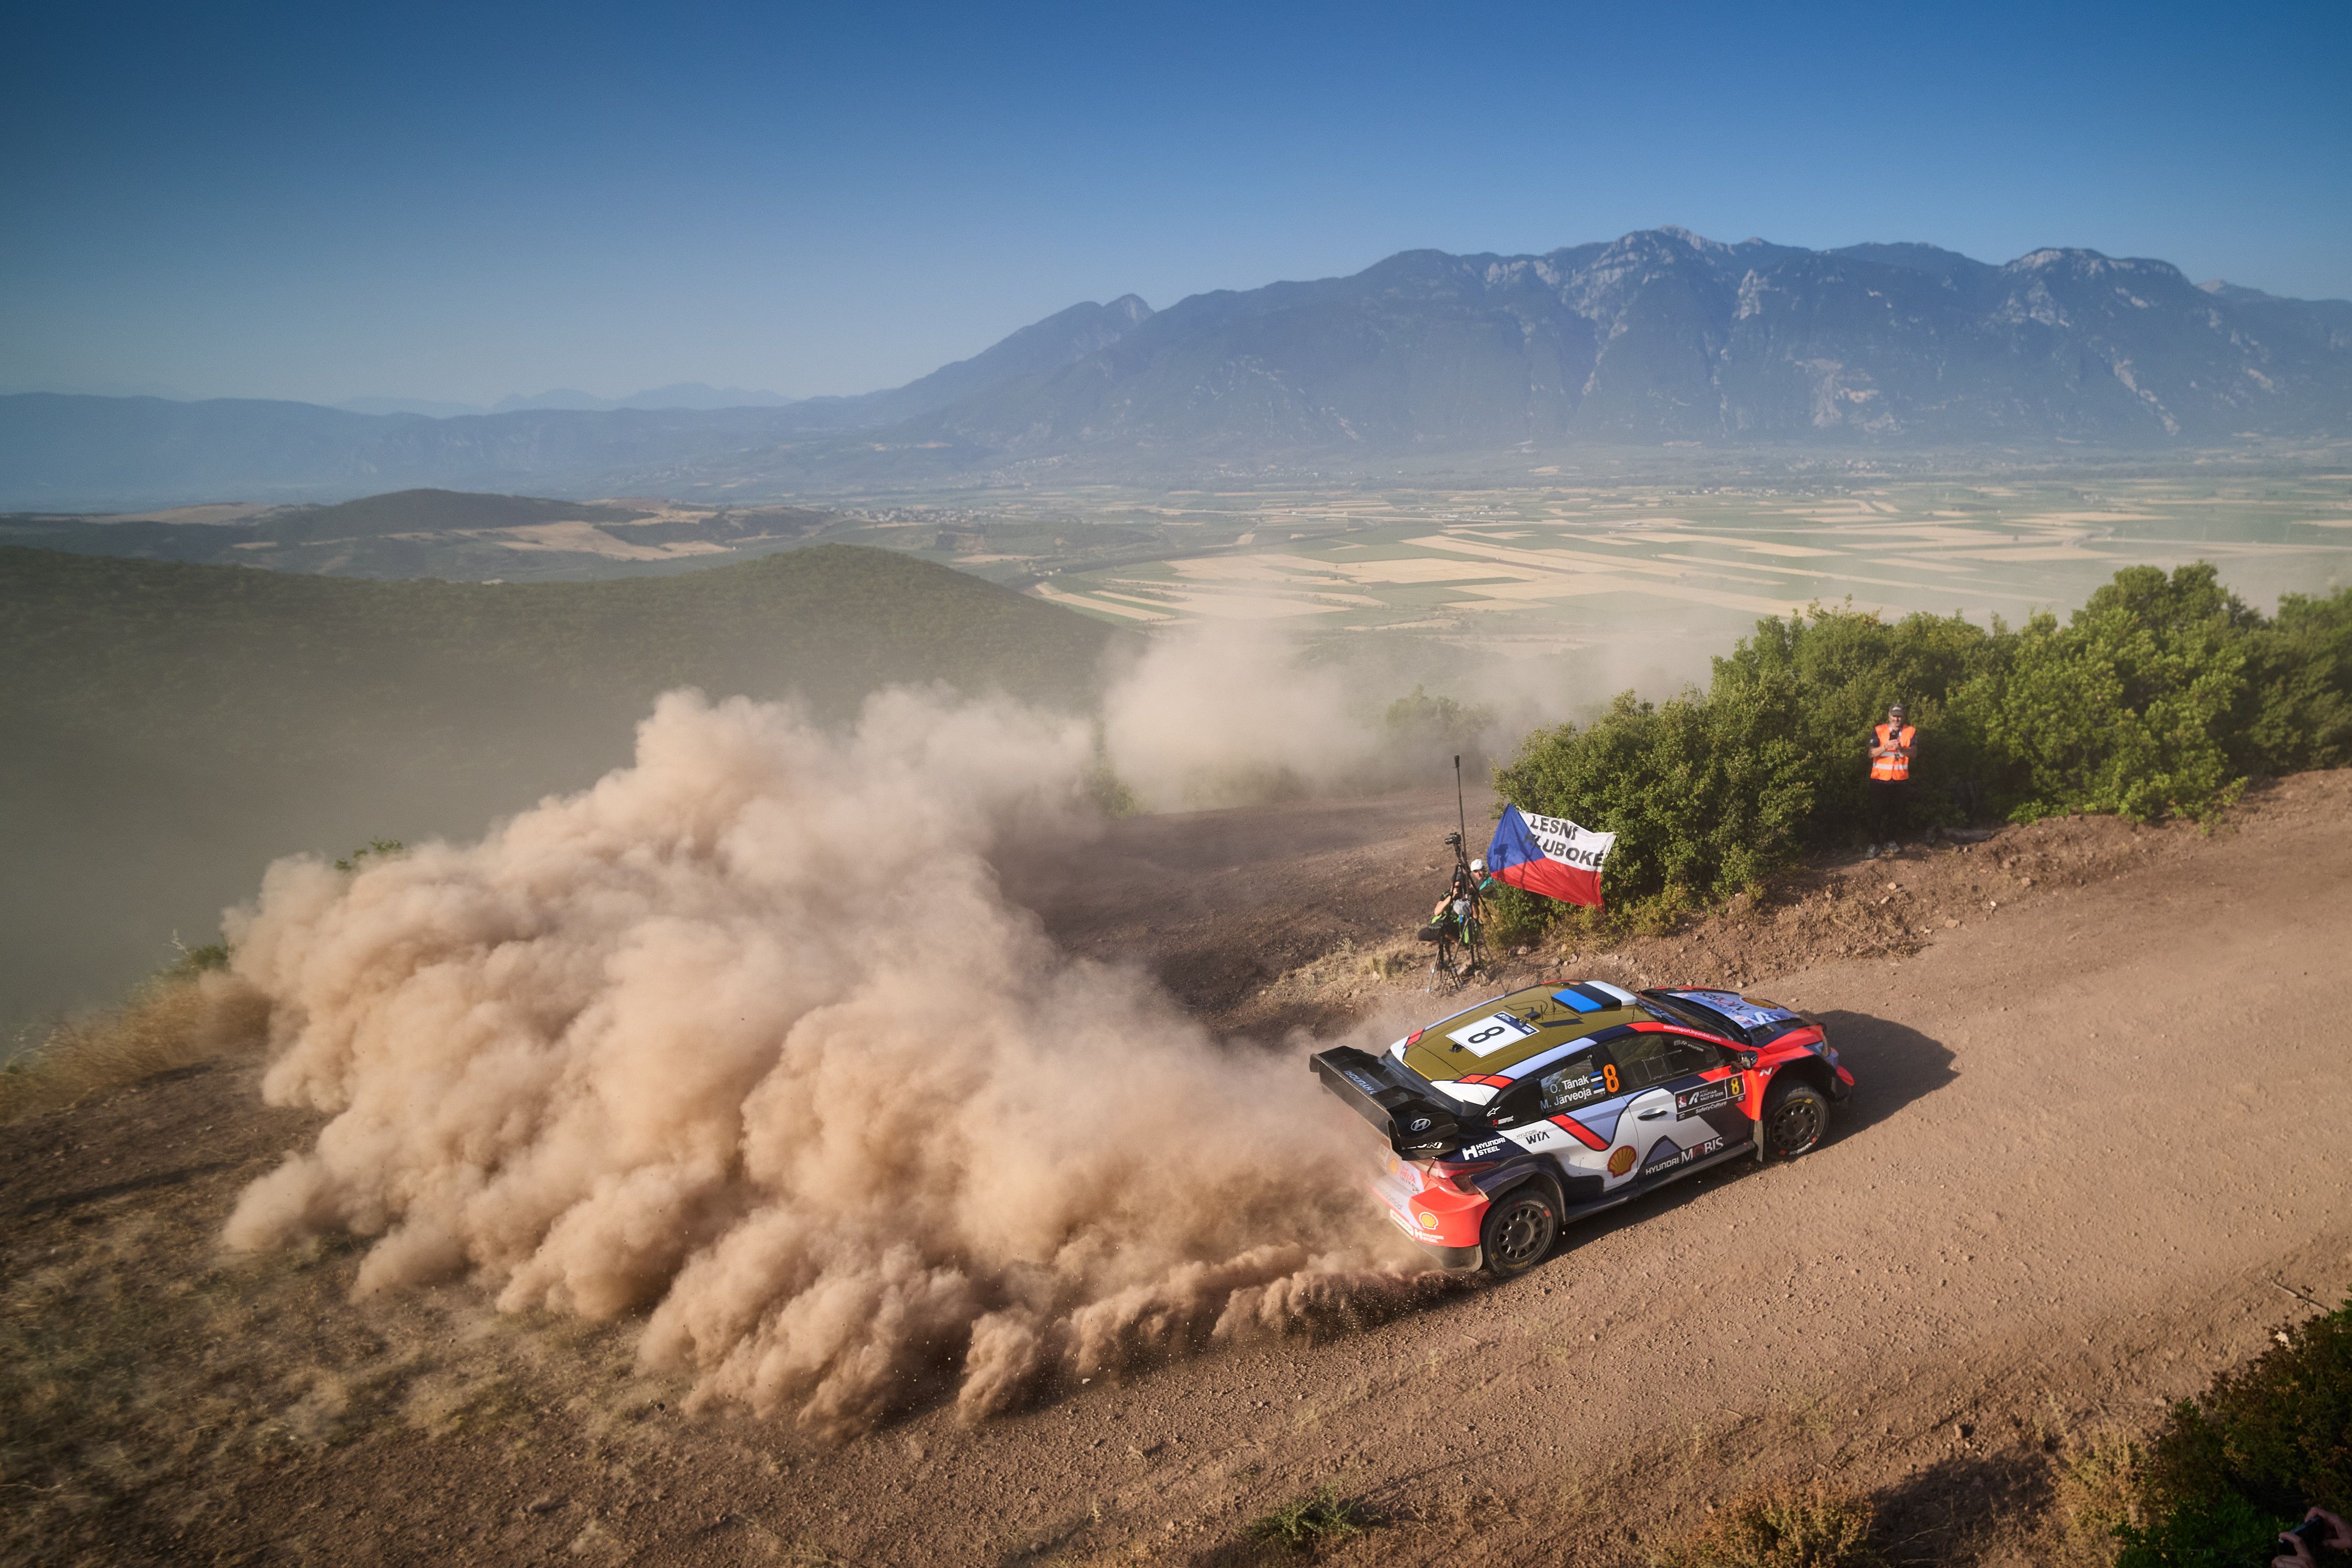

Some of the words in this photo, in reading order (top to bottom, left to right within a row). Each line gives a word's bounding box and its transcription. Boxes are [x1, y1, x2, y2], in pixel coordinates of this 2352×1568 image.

[1468, 1026, 1505, 1044] 8
[1664, 1025, 1721, 1042] motorsport.hyundai.com
[1603, 1064, 1620, 1093] 8
[1731, 1077, 1740, 1096] 8
[1550, 1084, 1561, 1094] O.
[1540, 1099, 1552, 1111] M.
[1554, 1087, 1592, 1106] Järveoja
[1695, 1101, 1727, 1114] SafetyCulture
[1475, 1137, 1506, 1150] HYUNDAI
[1478, 1146, 1501, 1156] STEEL
[1646, 1157, 1679, 1175] HYUNDAI
[1681, 1137, 1724, 1163] MOBIS
